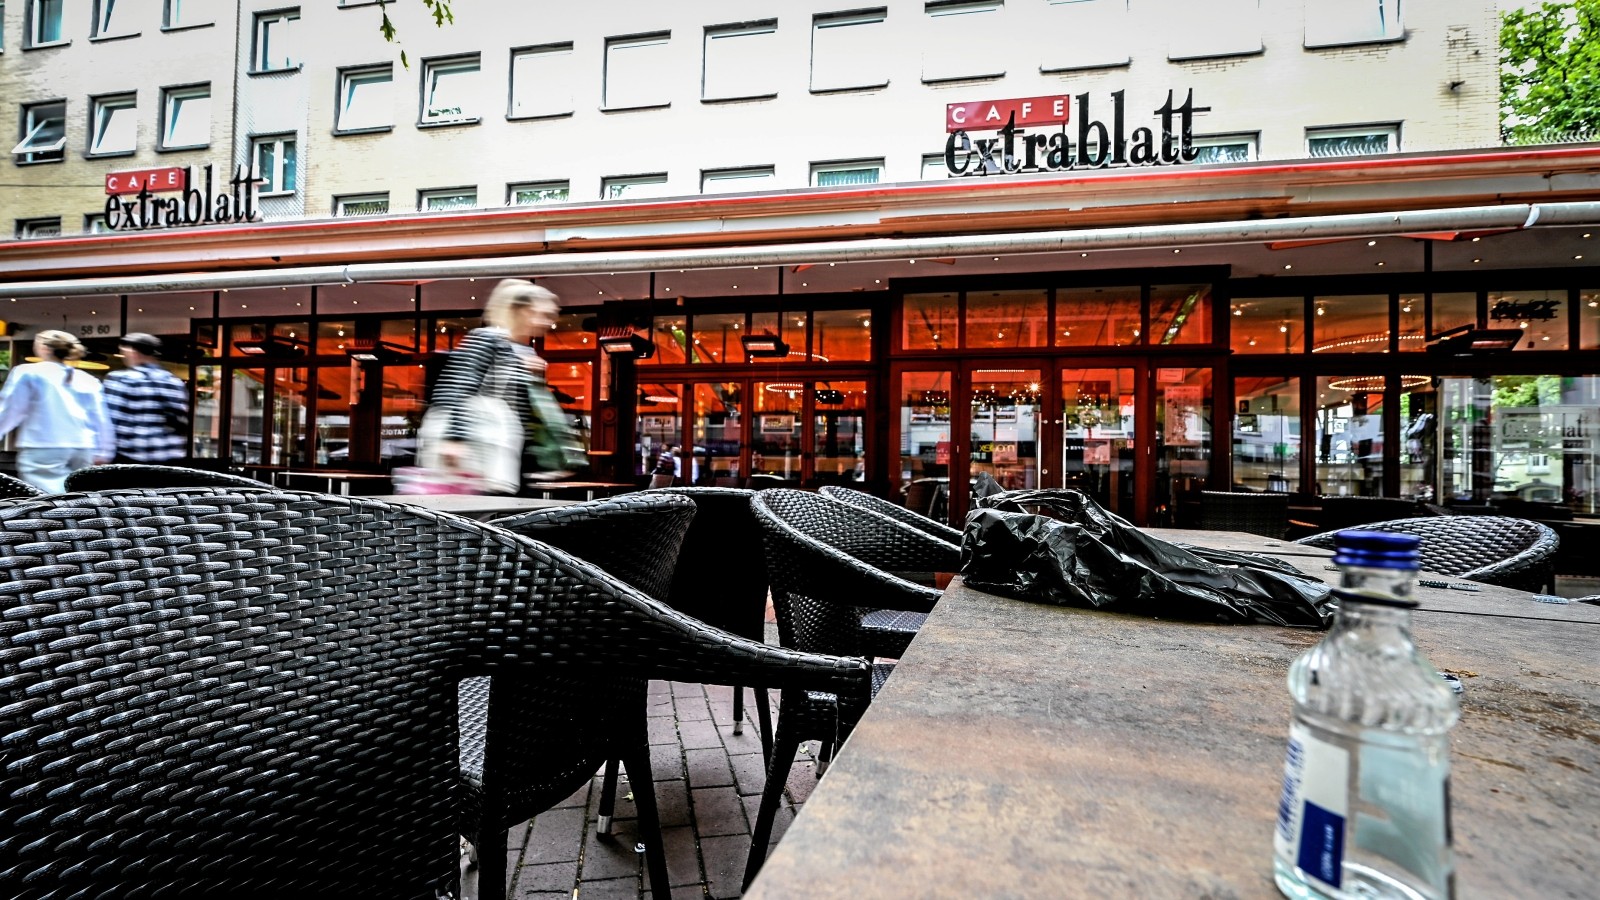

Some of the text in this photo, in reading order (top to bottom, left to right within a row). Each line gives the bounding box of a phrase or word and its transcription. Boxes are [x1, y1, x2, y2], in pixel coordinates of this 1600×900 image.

[952, 100, 1064, 123] CAFE
[944, 87, 1211, 176] extrablatt
[107, 171, 177, 190] CAFE
[105, 161, 264, 230] extrablatt
[81, 324, 110, 335] 58 60
